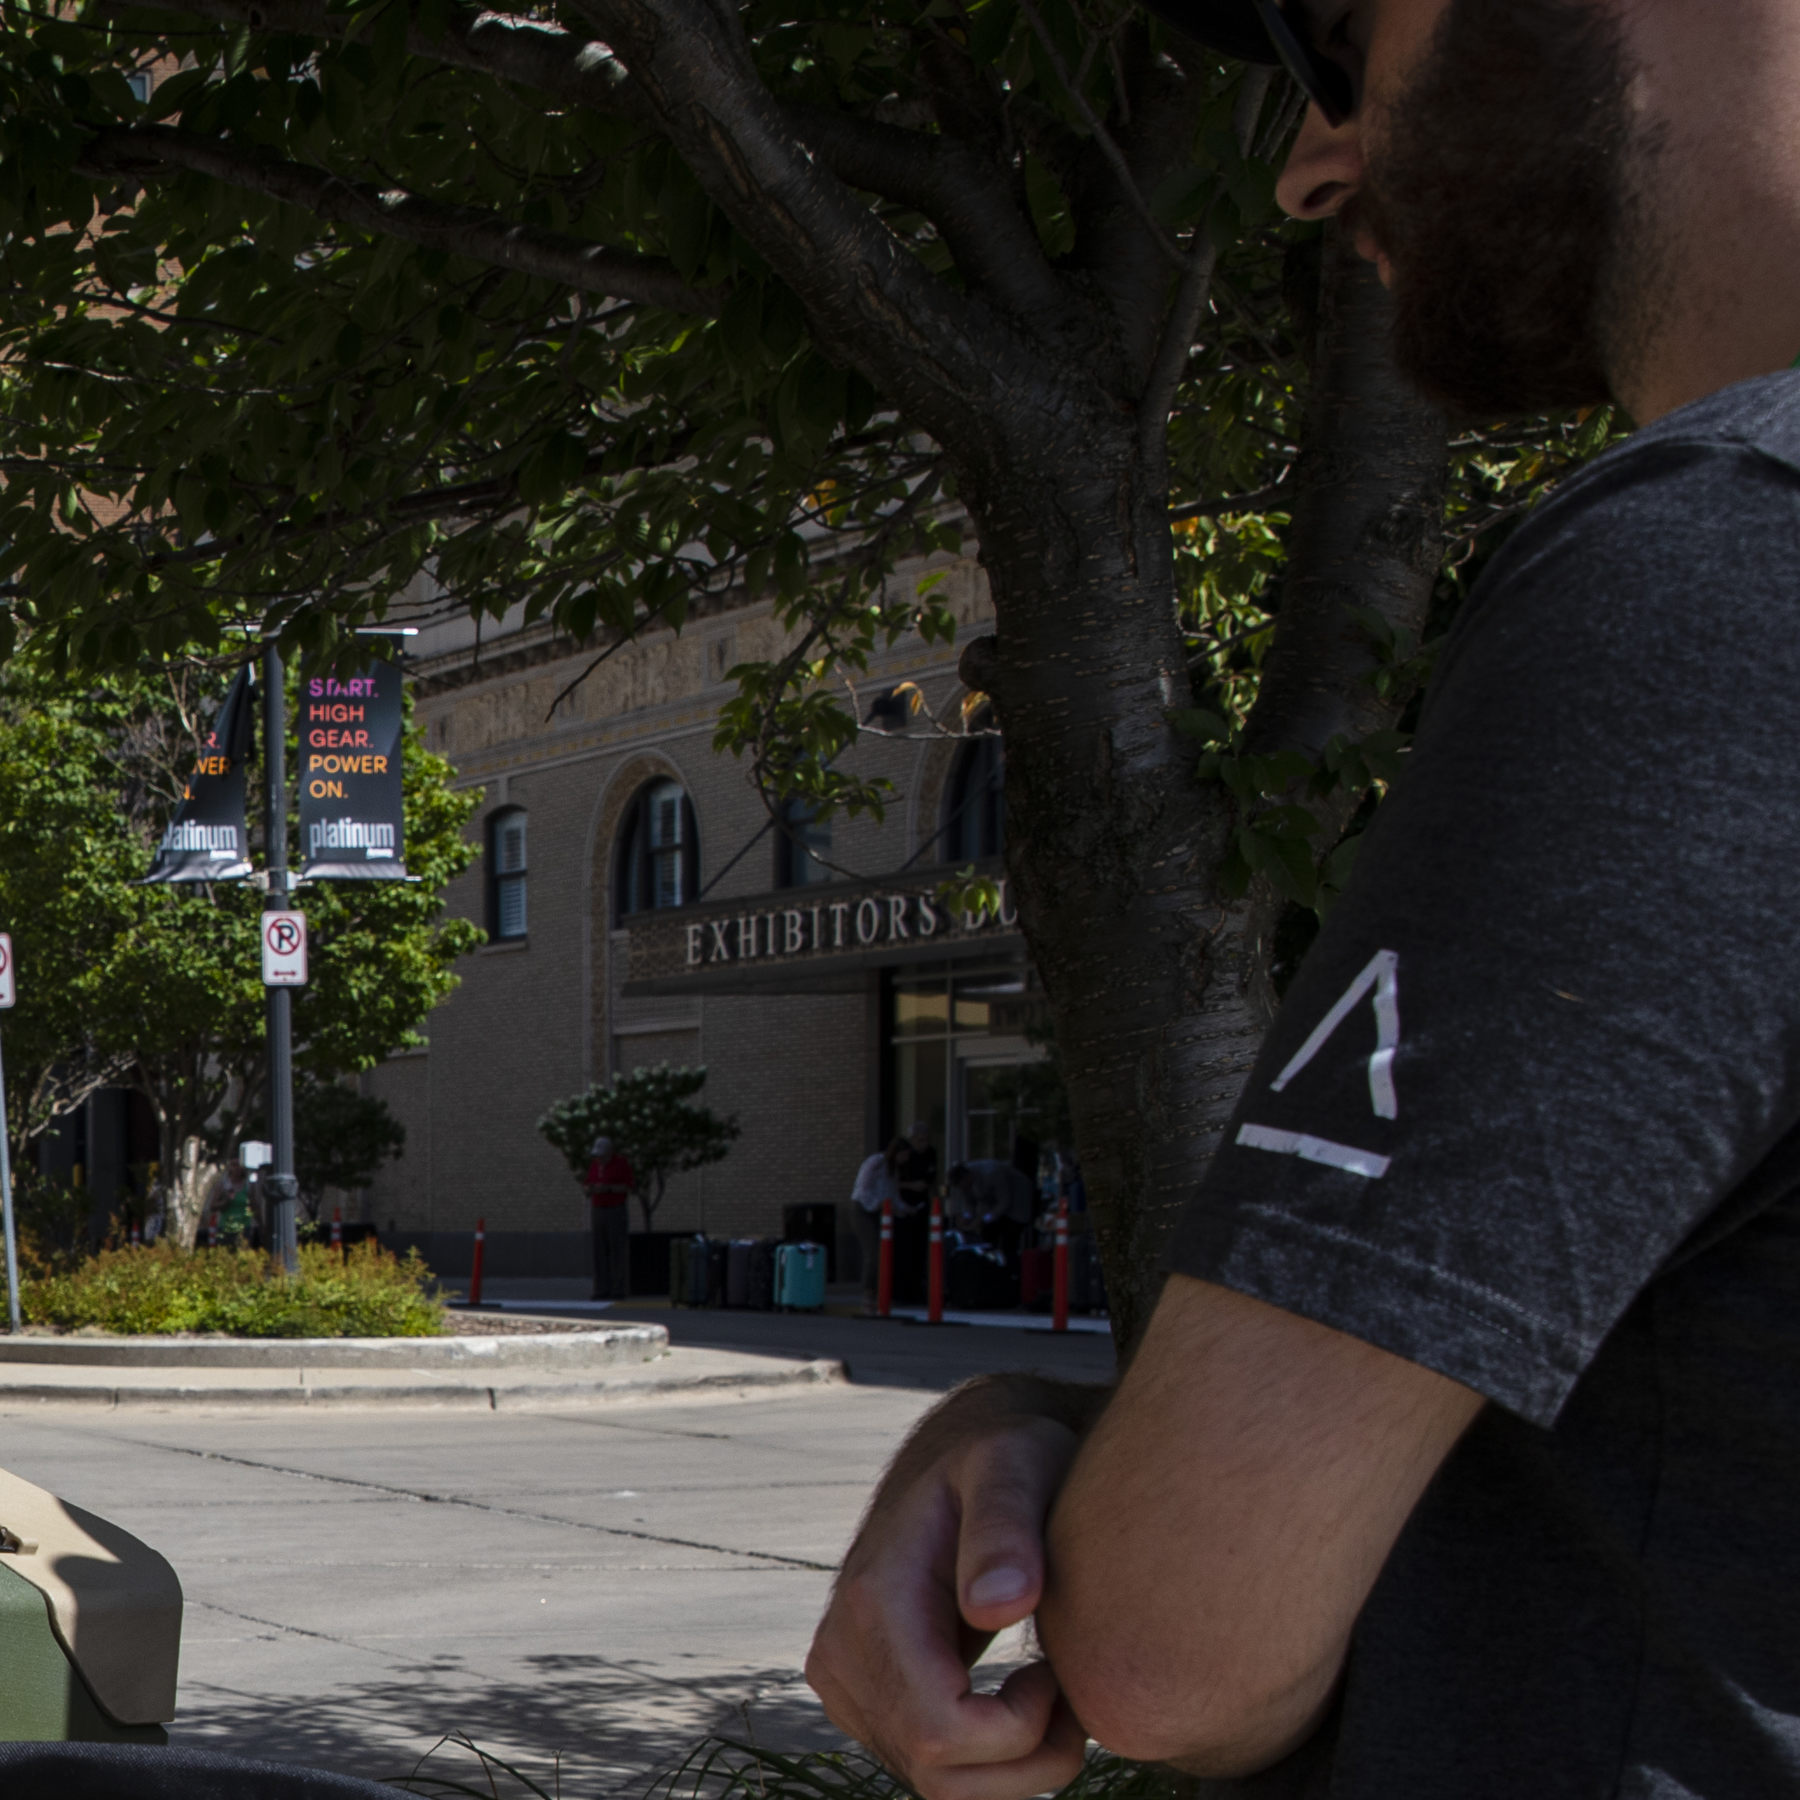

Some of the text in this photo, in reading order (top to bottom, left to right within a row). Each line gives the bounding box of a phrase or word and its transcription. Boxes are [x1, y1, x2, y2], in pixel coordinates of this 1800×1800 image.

[308, 678, 379, 698] START.
[308, 704, 365, 722] HIGH
[308, 729, 375, 749] GEAR.
[308, 754, 388, 774] POWER
[308, 779, 349, 799] ON.
[309, 817, 395, 859] platinum
[686, 894, 938, 966] EXHIBITORS
